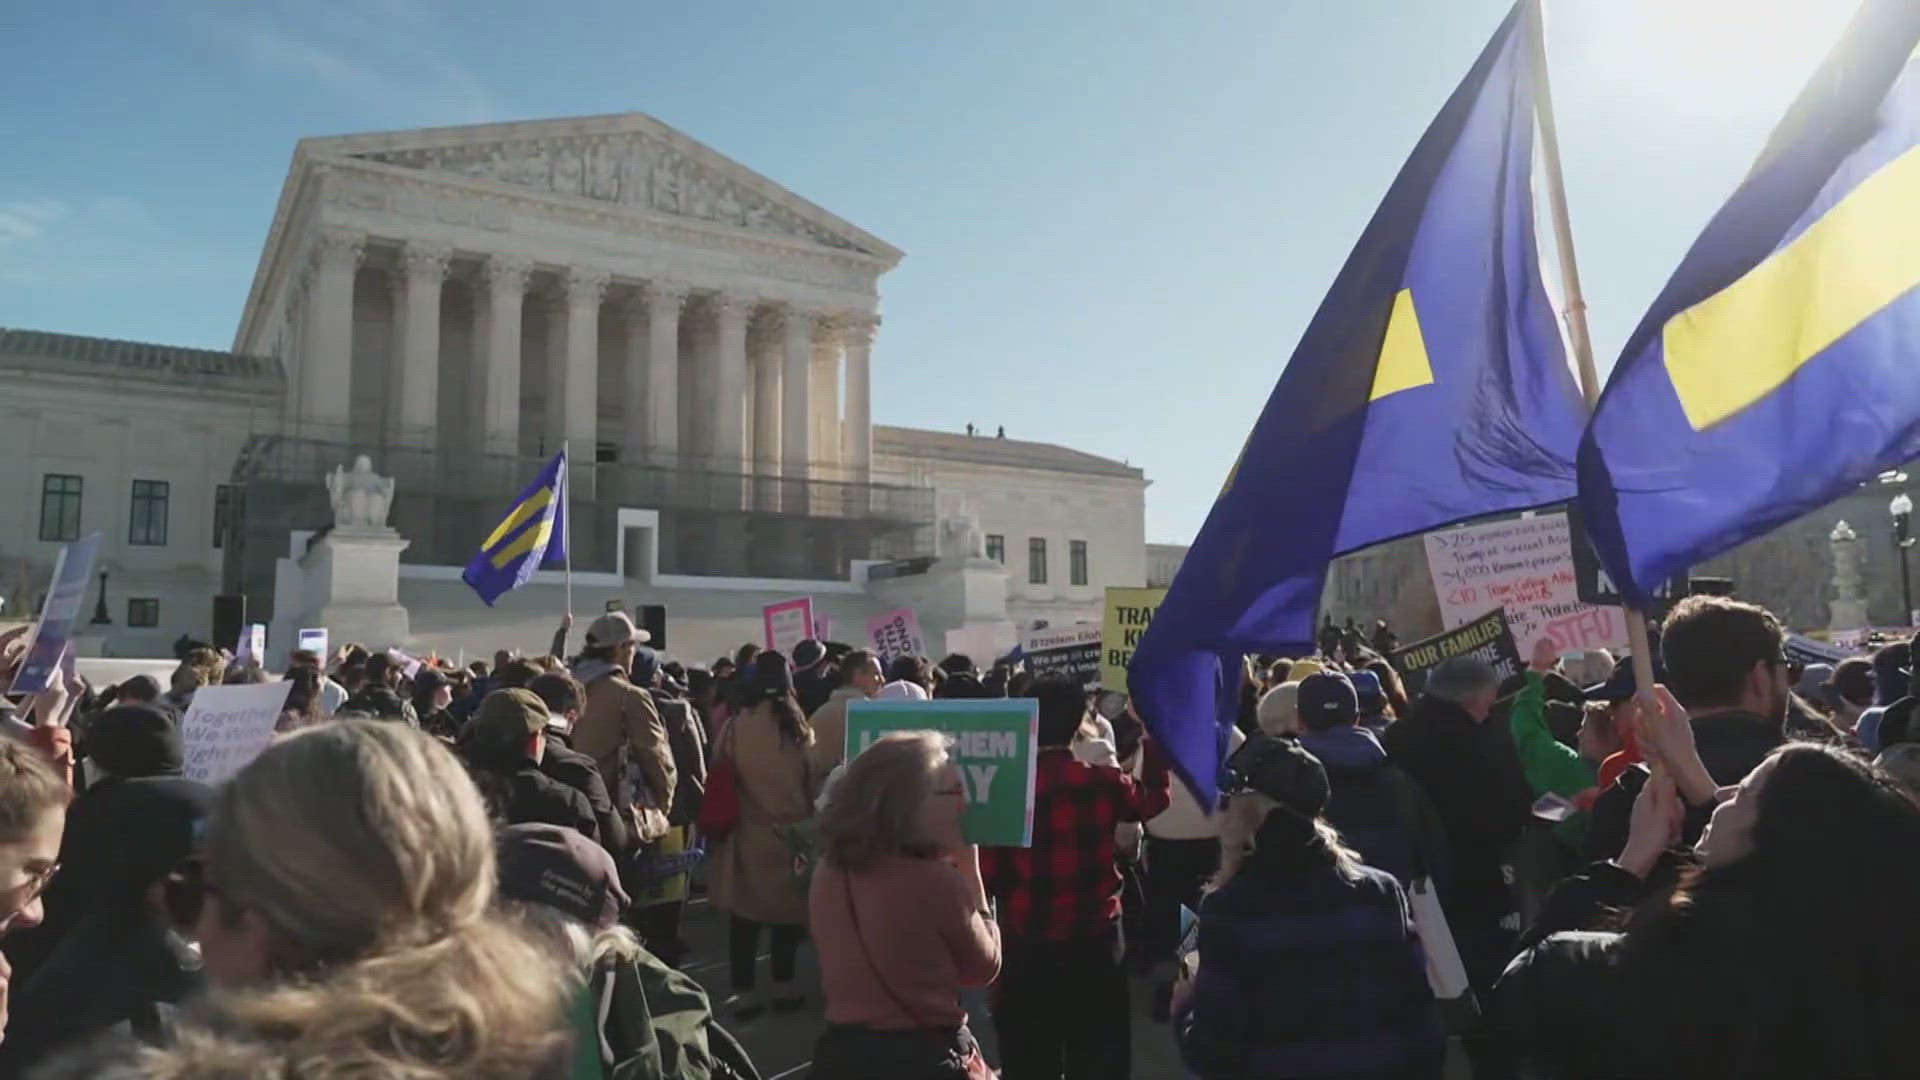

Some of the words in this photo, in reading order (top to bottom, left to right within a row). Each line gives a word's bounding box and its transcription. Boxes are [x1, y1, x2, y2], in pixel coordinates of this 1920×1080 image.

[1404, 645, 1439, 670] OUR
[1439, 616, 1503, 657] FAMILIES
[1545, 609, 1613, 652] STFU
[1031, 655, 1049, 666] We
[1052, 653, 1068, 664] are
[948, 729, 1017, 759] HEM
